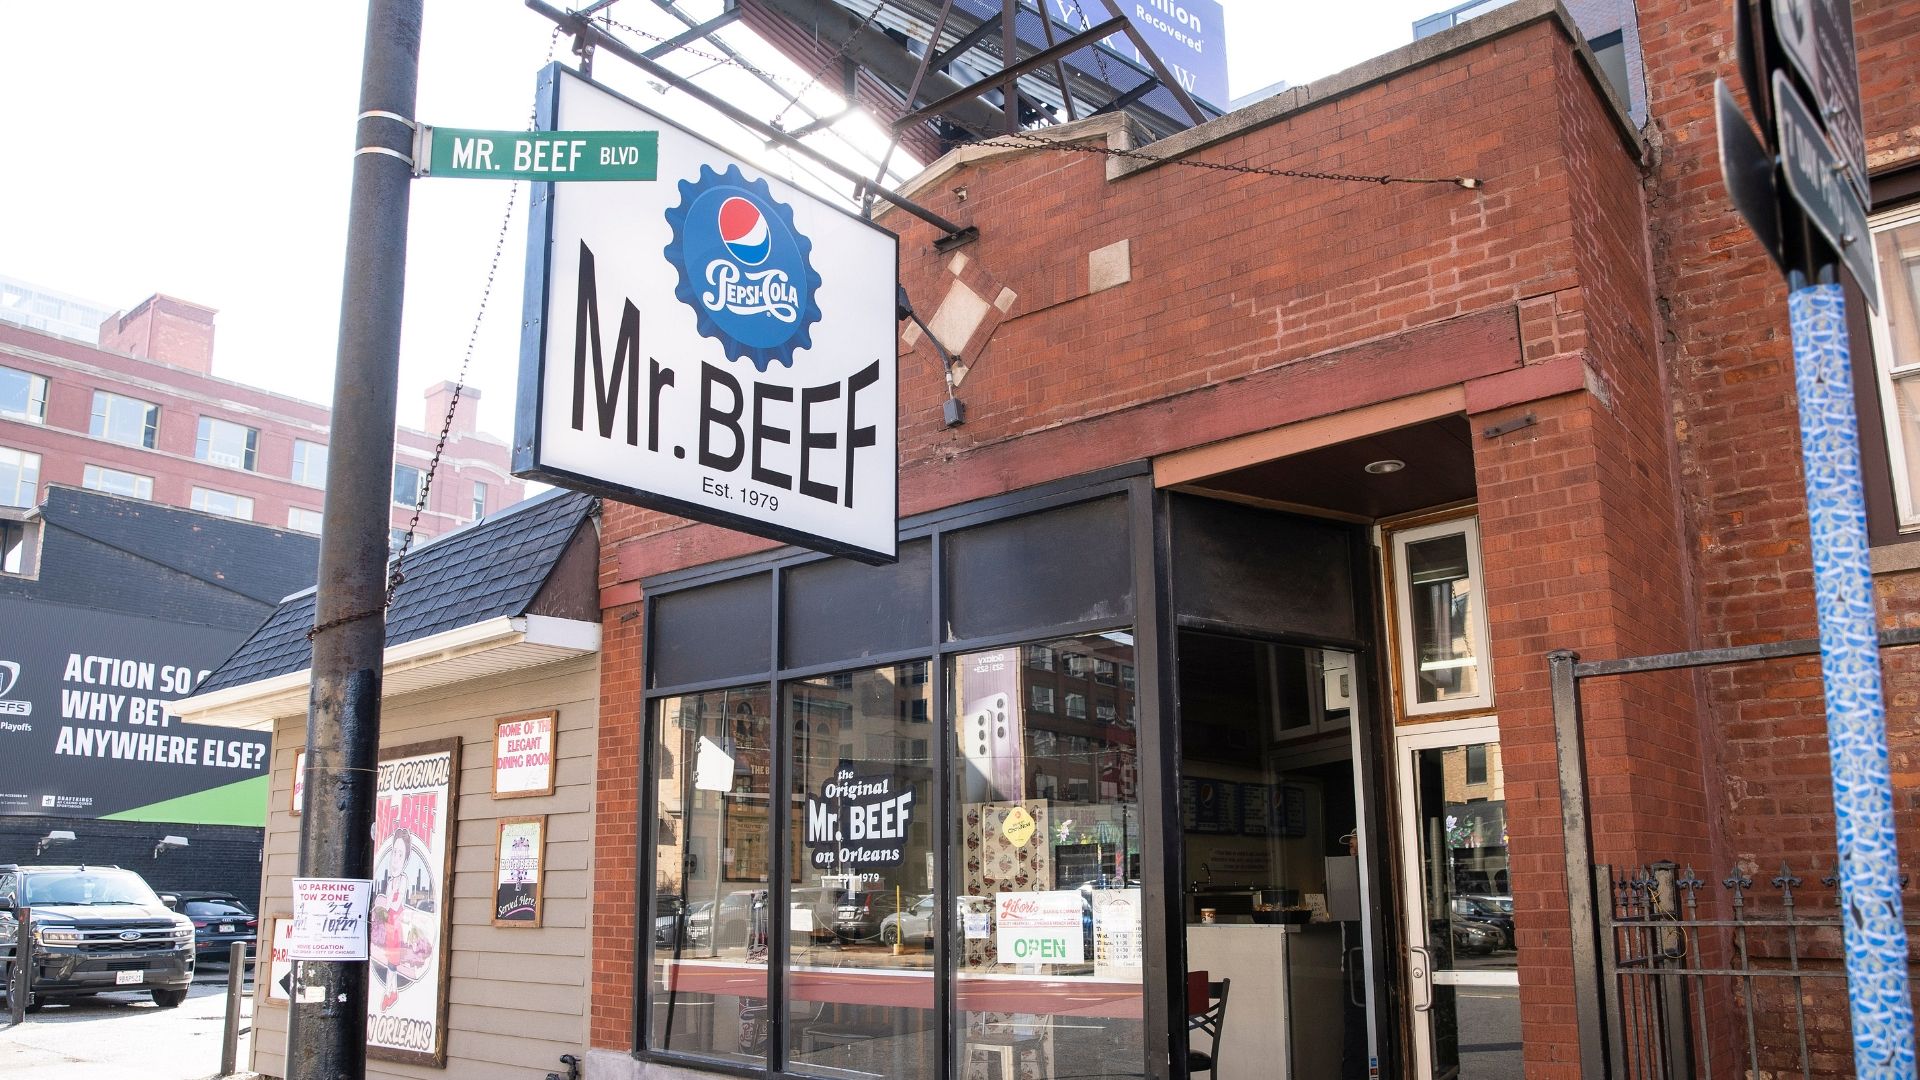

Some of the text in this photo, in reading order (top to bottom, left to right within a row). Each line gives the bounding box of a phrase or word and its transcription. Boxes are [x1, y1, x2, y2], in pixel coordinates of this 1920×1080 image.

[1136, 4, 1202, 53] Recovered
[452, 138, 639, 172] MR. BEEF BLVD
[572, 238, 880, 508] Mr. BEEF
[703, 477, 779, 511] Est. 1979
[64, 653, 155, 691] ACTION
[160, 665, 191, 694] SO
[61, 689, 172, 728] WHY BET
[1, 721, 32, 732] Playoffs
[499, 723, 521, 738] HOME
[524, 721, 535, 735] OF
[55, 726, 266, 770] ANYWHERE ELSE?
[507, 736, 542, 753] ELEGANT
[377, 757, 450, 792] HE ORIGINAL
[496, 754, 524, 770] DINING
[838, 770, 854, 780] the
[825, 779, 889, 800] Original
[809, 791, 912, 842] Mr. BEEF
[815, 847, 900, 863] on Orleans
[300, 893, 349, 901] TOW ZONE
[310, 884, 355, 892] PARKING
[1014, 938, 1066, 958] OPEN
[377, 1015, 433, 1051] ORLEANS
